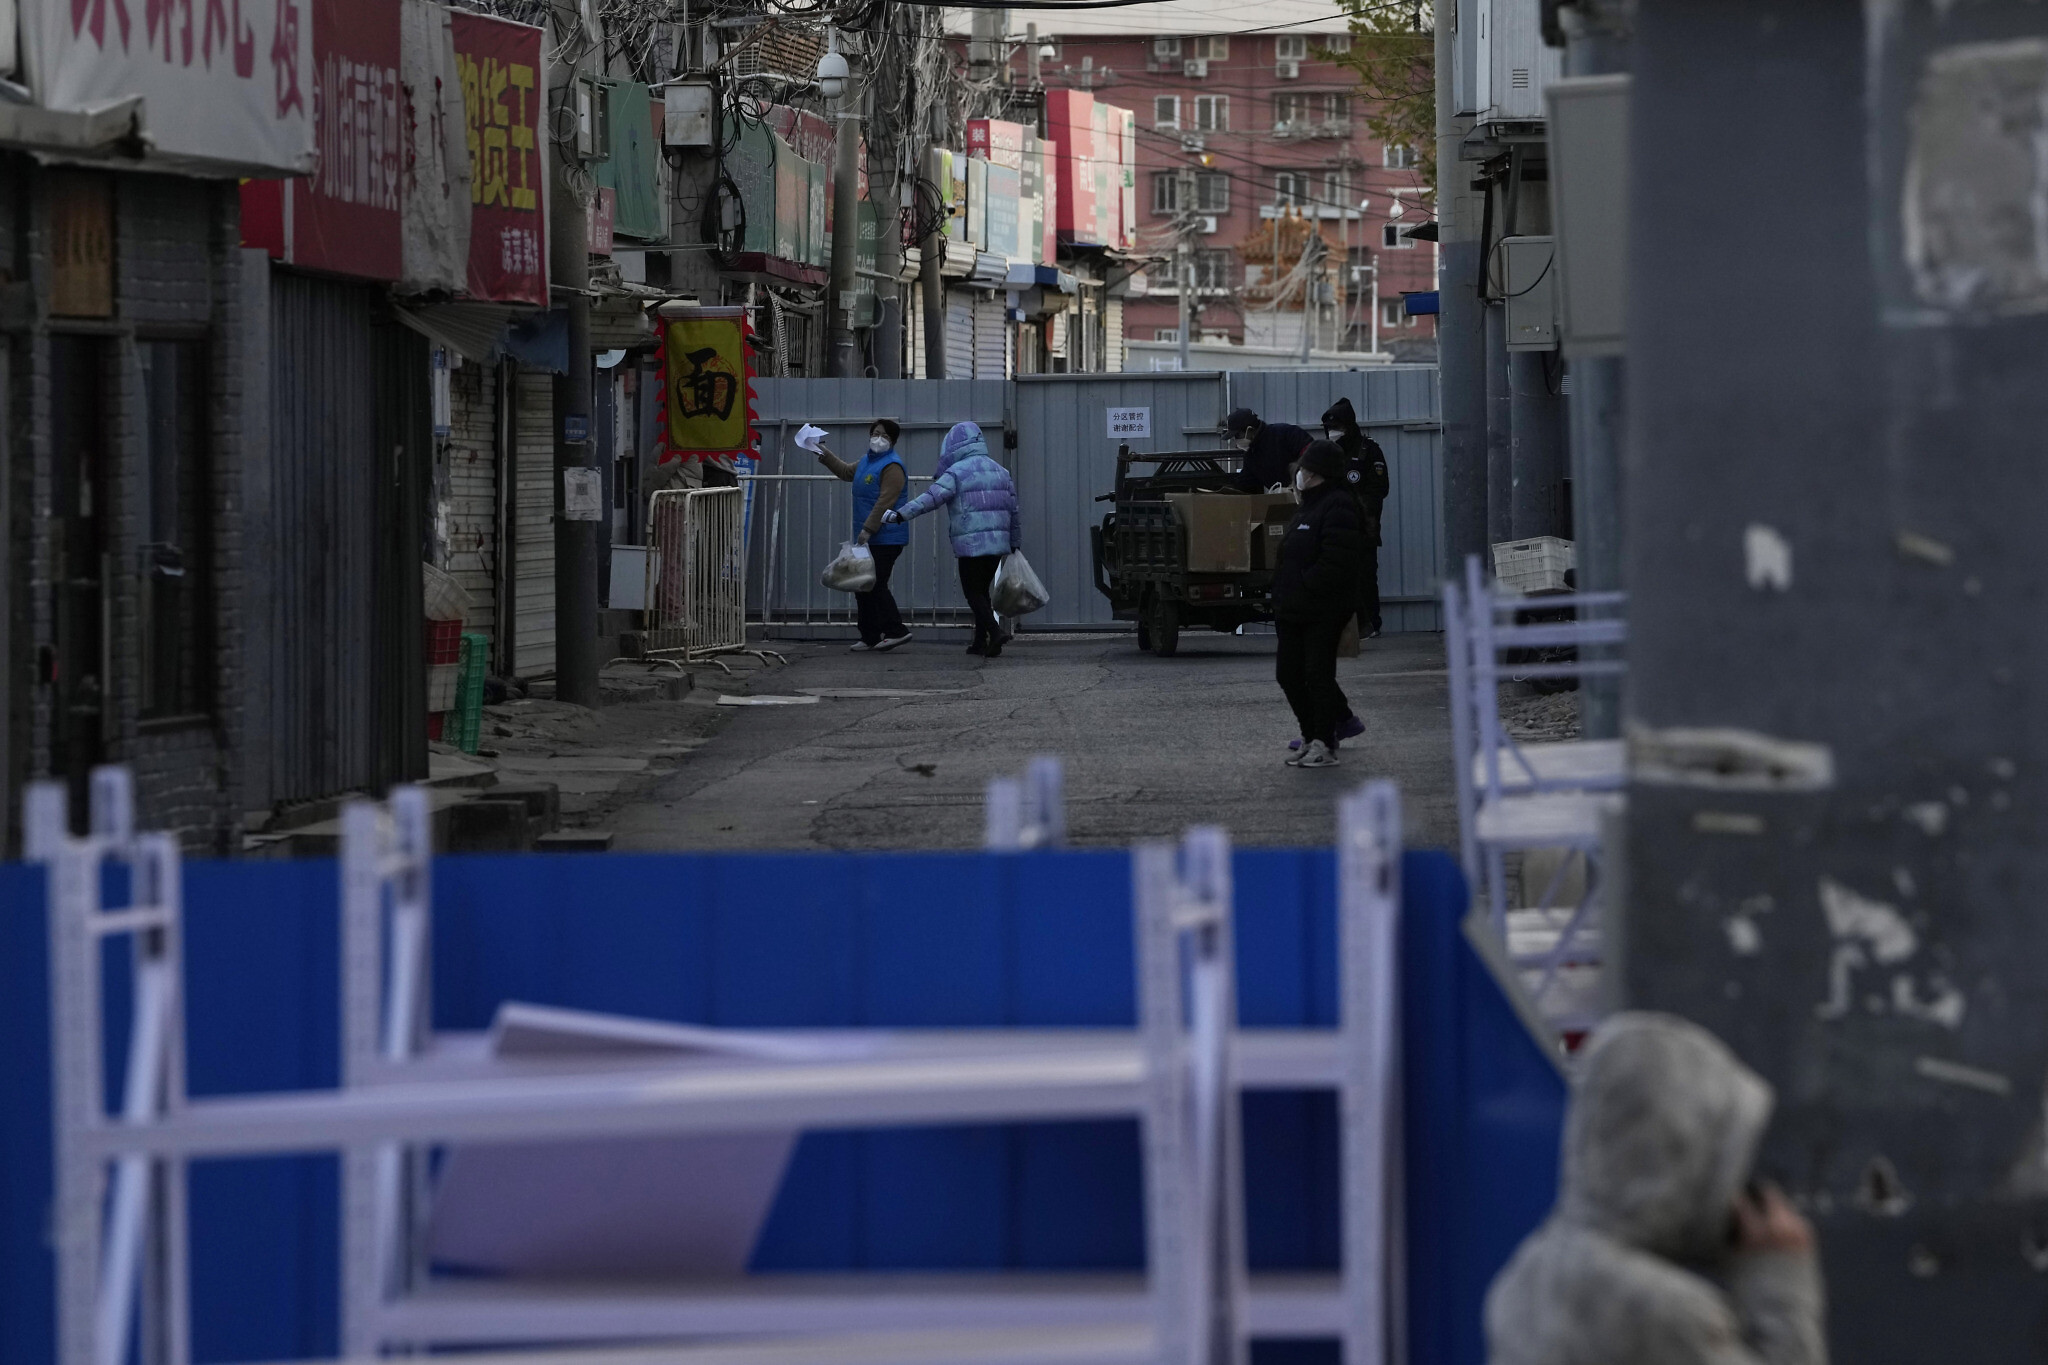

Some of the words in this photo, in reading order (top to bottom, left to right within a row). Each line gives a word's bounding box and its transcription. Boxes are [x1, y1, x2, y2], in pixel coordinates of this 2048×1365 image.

[676, 347, 737, 422] 面
[1113, 412, 1144, 421] 分区管控
[1113, 424, 1144, 432] 谢谢配合
